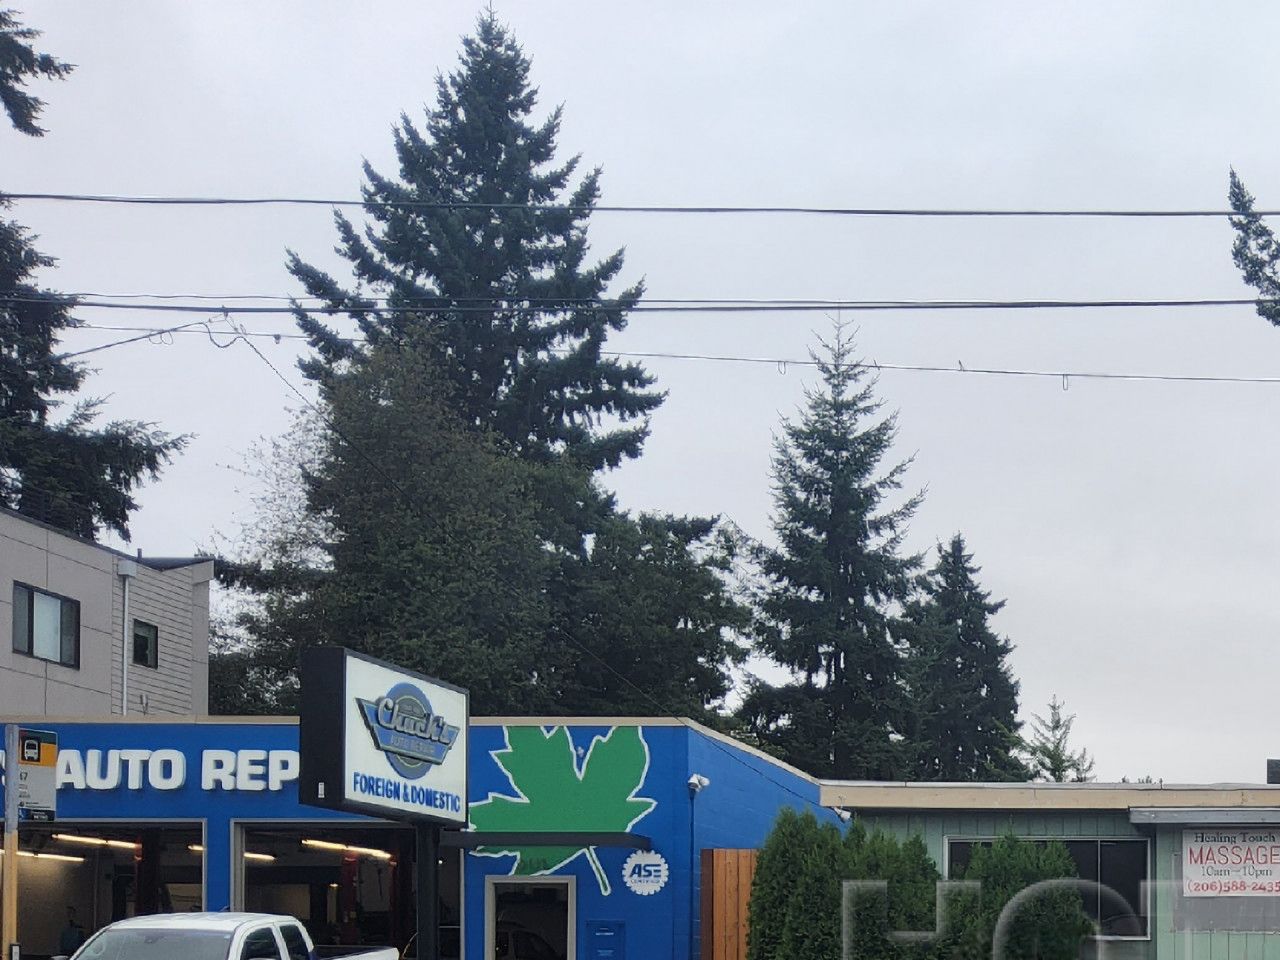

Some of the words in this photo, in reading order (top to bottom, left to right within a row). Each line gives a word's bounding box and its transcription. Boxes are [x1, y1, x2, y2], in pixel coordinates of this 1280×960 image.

[57, 749, 186, 791] AUTO
[353, 771, 401, 801] FOREIGN
[402, 781, 411, 803] &
[411, 784, 461, 813] DOMESTIC
[1194, 832, 1237, 844] Healing
[1241, 832, 1276, 843] Touch
[629, 863, 662, 878] ASE
